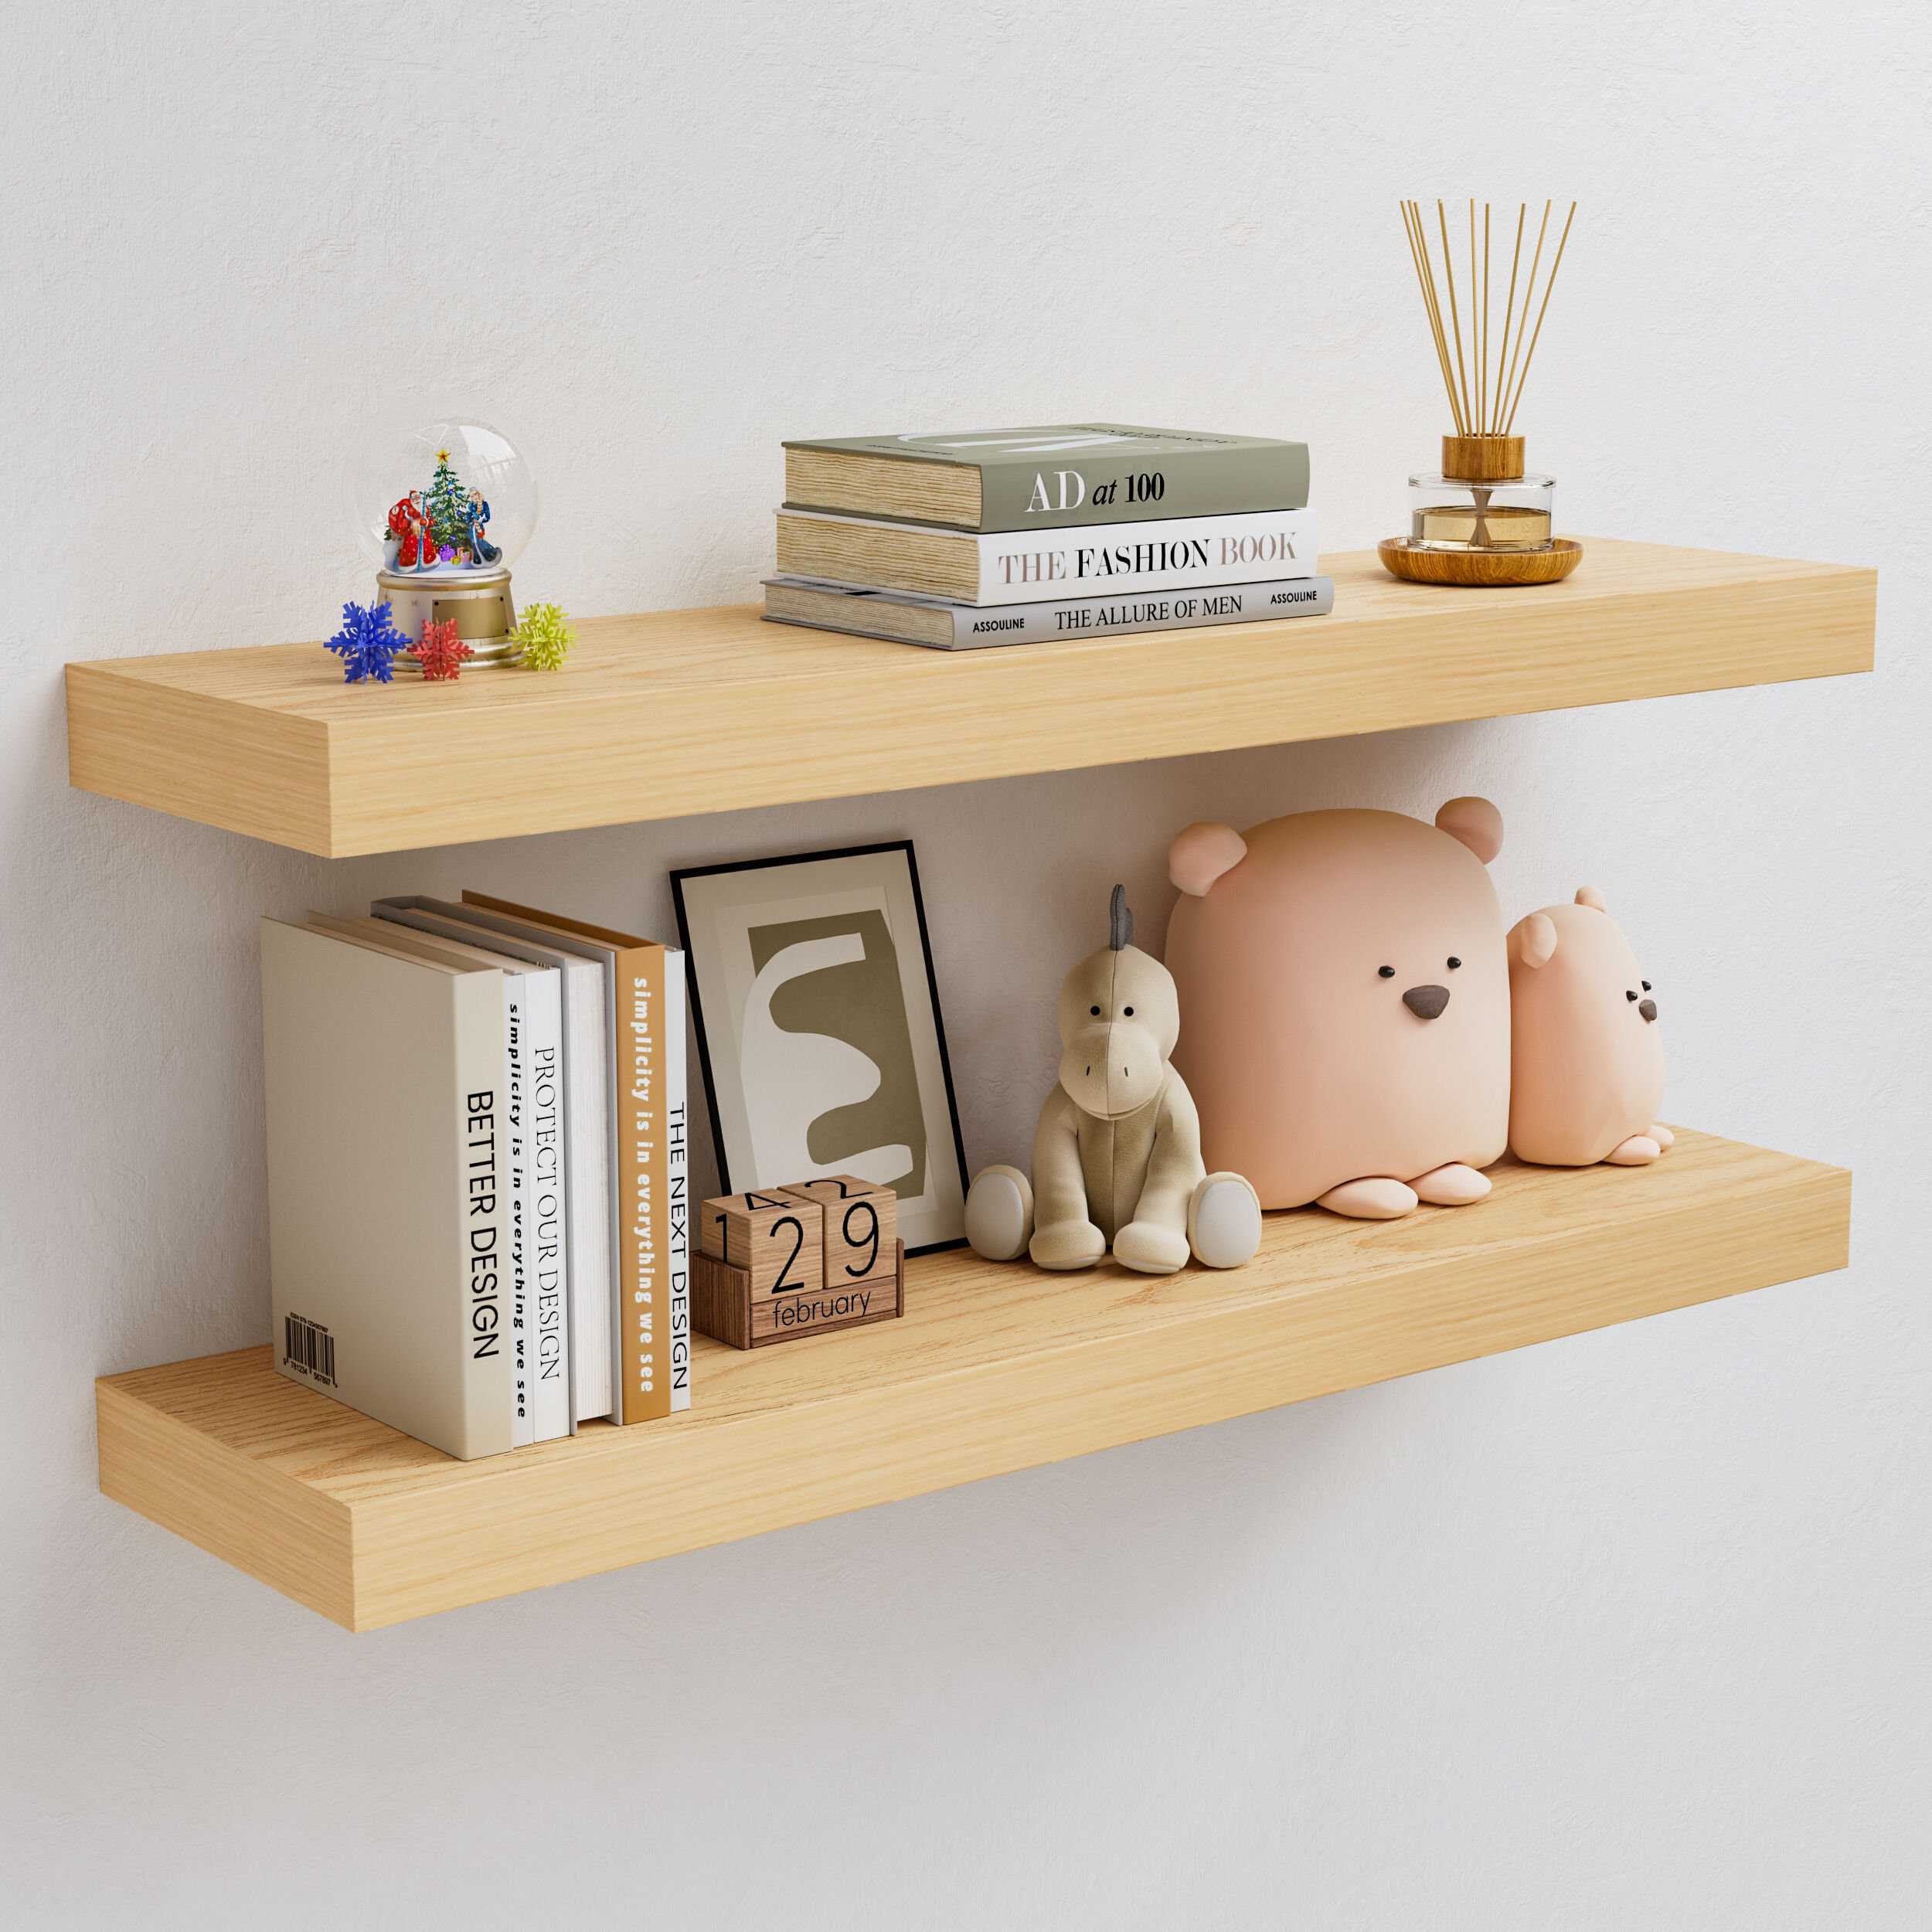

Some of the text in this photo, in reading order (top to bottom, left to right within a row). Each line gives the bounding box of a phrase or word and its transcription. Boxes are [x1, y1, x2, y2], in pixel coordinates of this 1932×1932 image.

[1024, 471, 1165, 512] AD at 100
[998, 532, 1299, 584] THE FASHION BOOK
[1055, 595, 1243, 630] THE ALLURE OF MEN
[1270, 590, 1318, 604] ASSOULINE
[972, 617, 1025, 633] ASSOULINE
[630, 978, 656, 1392] simplicity is in everything we see
[744, 1192, 792, 1211] 4
[468, 1090, 499, 1359] BETTER DESIGN
[508, 1003, 526, 1418] simplicity is in everything we see
[535, 1046, 560, 1380] PROTECT OUR DESIGN
[670, 1101, 688, 1389] THE NEXT DESIGN
[716, 1213, 727, 1263] 1
[773, 1291, 871, 1328] february
